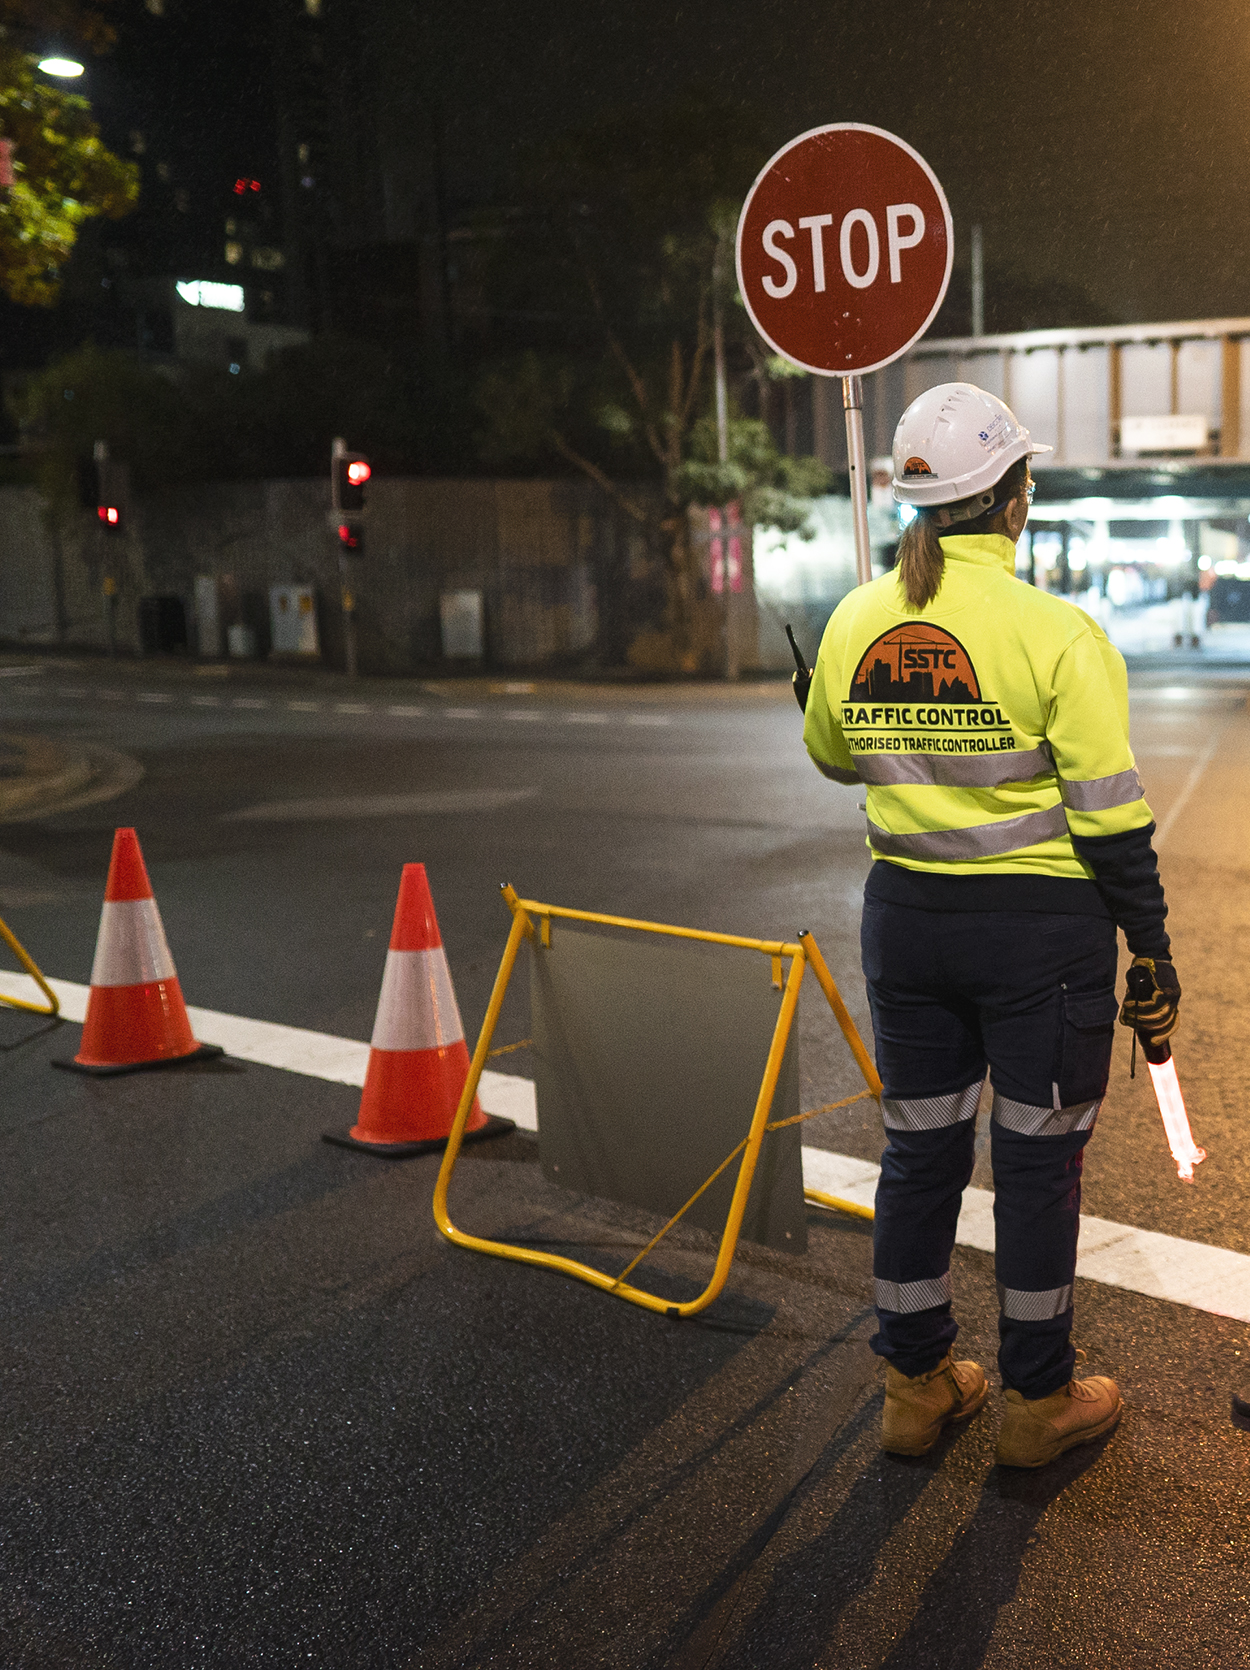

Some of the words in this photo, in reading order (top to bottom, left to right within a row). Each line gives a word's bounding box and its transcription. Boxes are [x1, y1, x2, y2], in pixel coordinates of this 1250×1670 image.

[761, 202, 926, 299] STOP
[903, 648, 957, 670] SSTC
[841, 707, 913, 725] RAFFIC
[915, 707, 1011, 726] CONTROL
[848, 736, 901, 751] THORISED
[902, 736, 942, 752] TRAFFIC
[942, 736, 1016, 753] CONTROLLER
